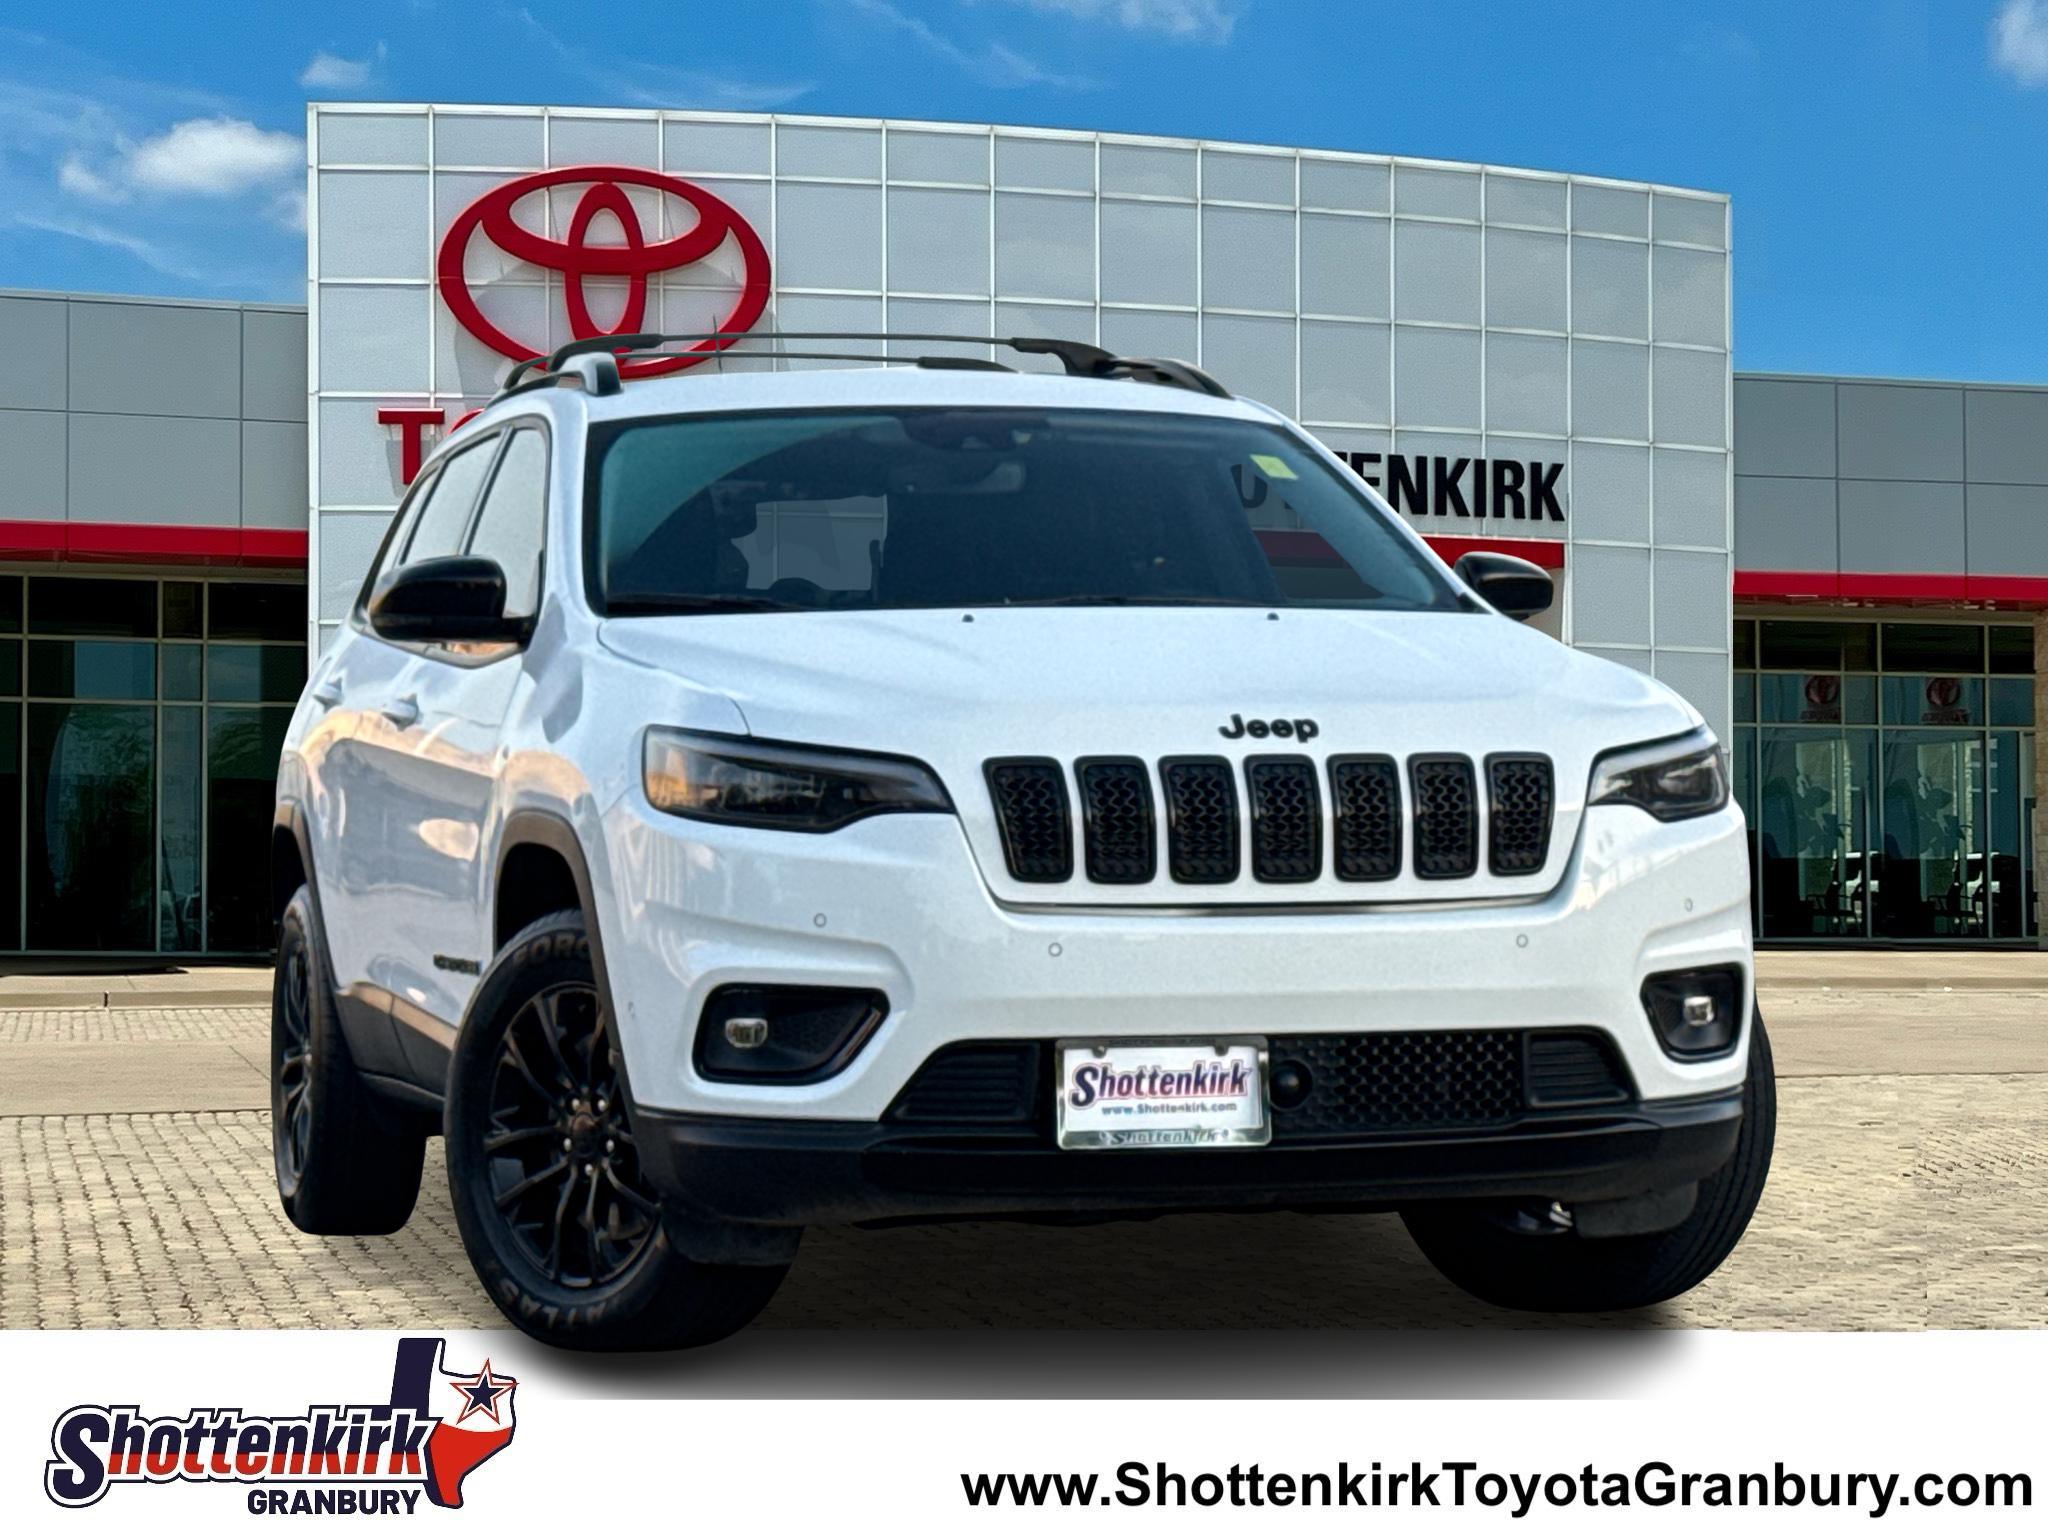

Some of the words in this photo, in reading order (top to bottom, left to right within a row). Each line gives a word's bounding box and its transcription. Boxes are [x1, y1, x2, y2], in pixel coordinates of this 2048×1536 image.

[1217, 713, 1320, 743] Jeep
[1070, 1062, 1249, 1108] Shottenkirk
[1101, 1101, 1238, 1116] www.Shottenkirk.com
